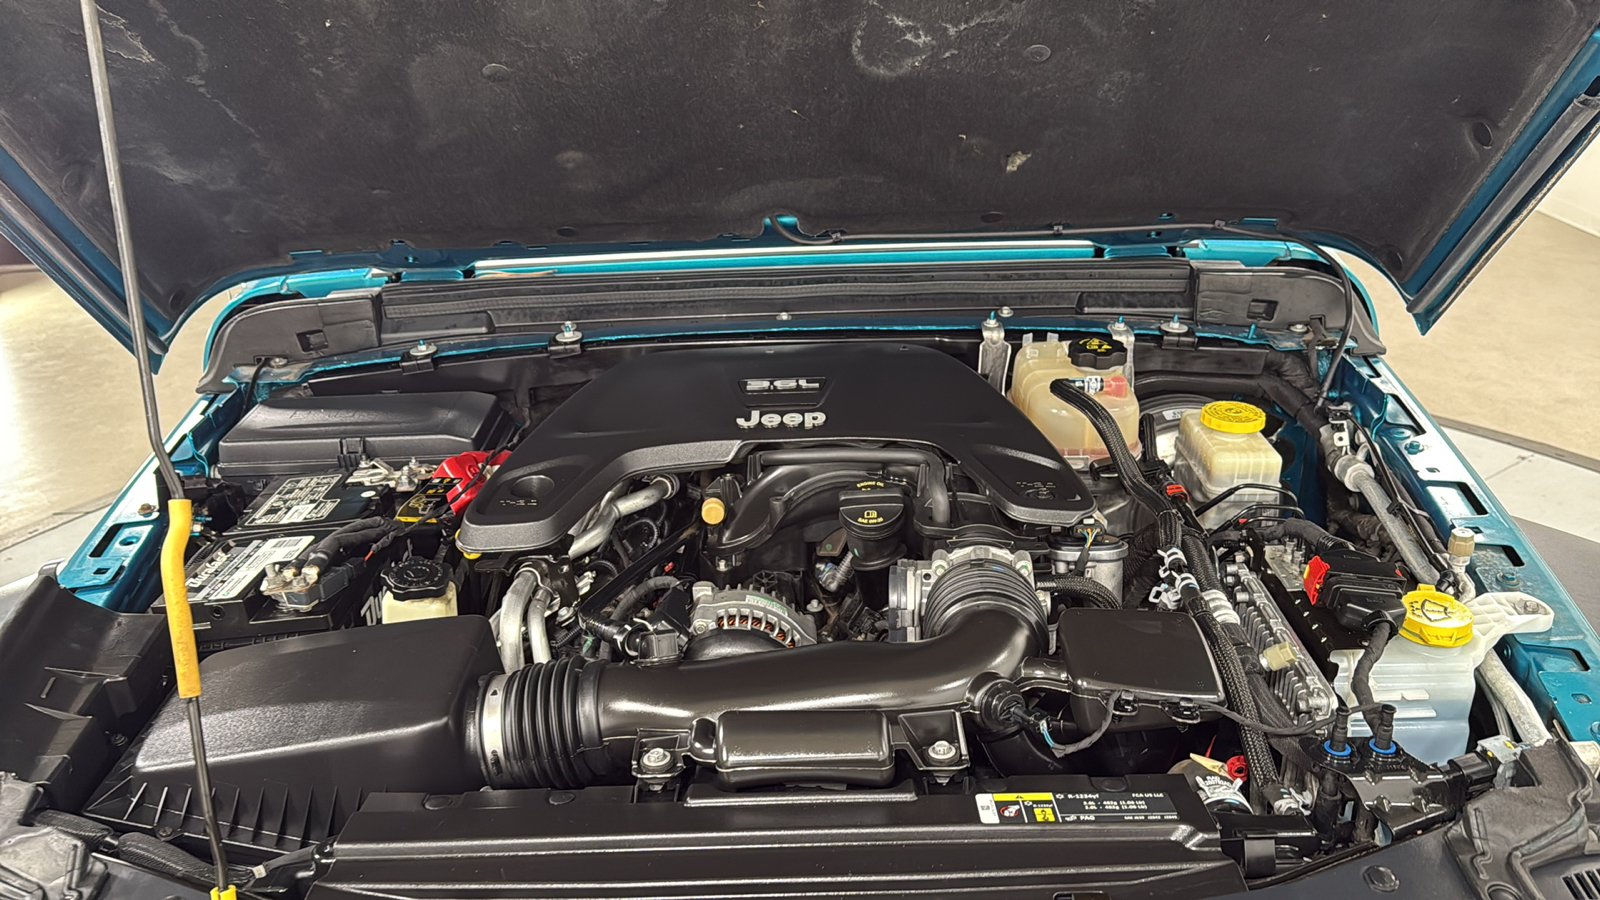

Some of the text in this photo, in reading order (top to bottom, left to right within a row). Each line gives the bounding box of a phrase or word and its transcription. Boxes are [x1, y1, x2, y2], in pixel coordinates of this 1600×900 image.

[746, 379, 820, 390] 3.6L
[736, 410, 826, 429] Jeep
[185, 551, 231, 587] Duralast
